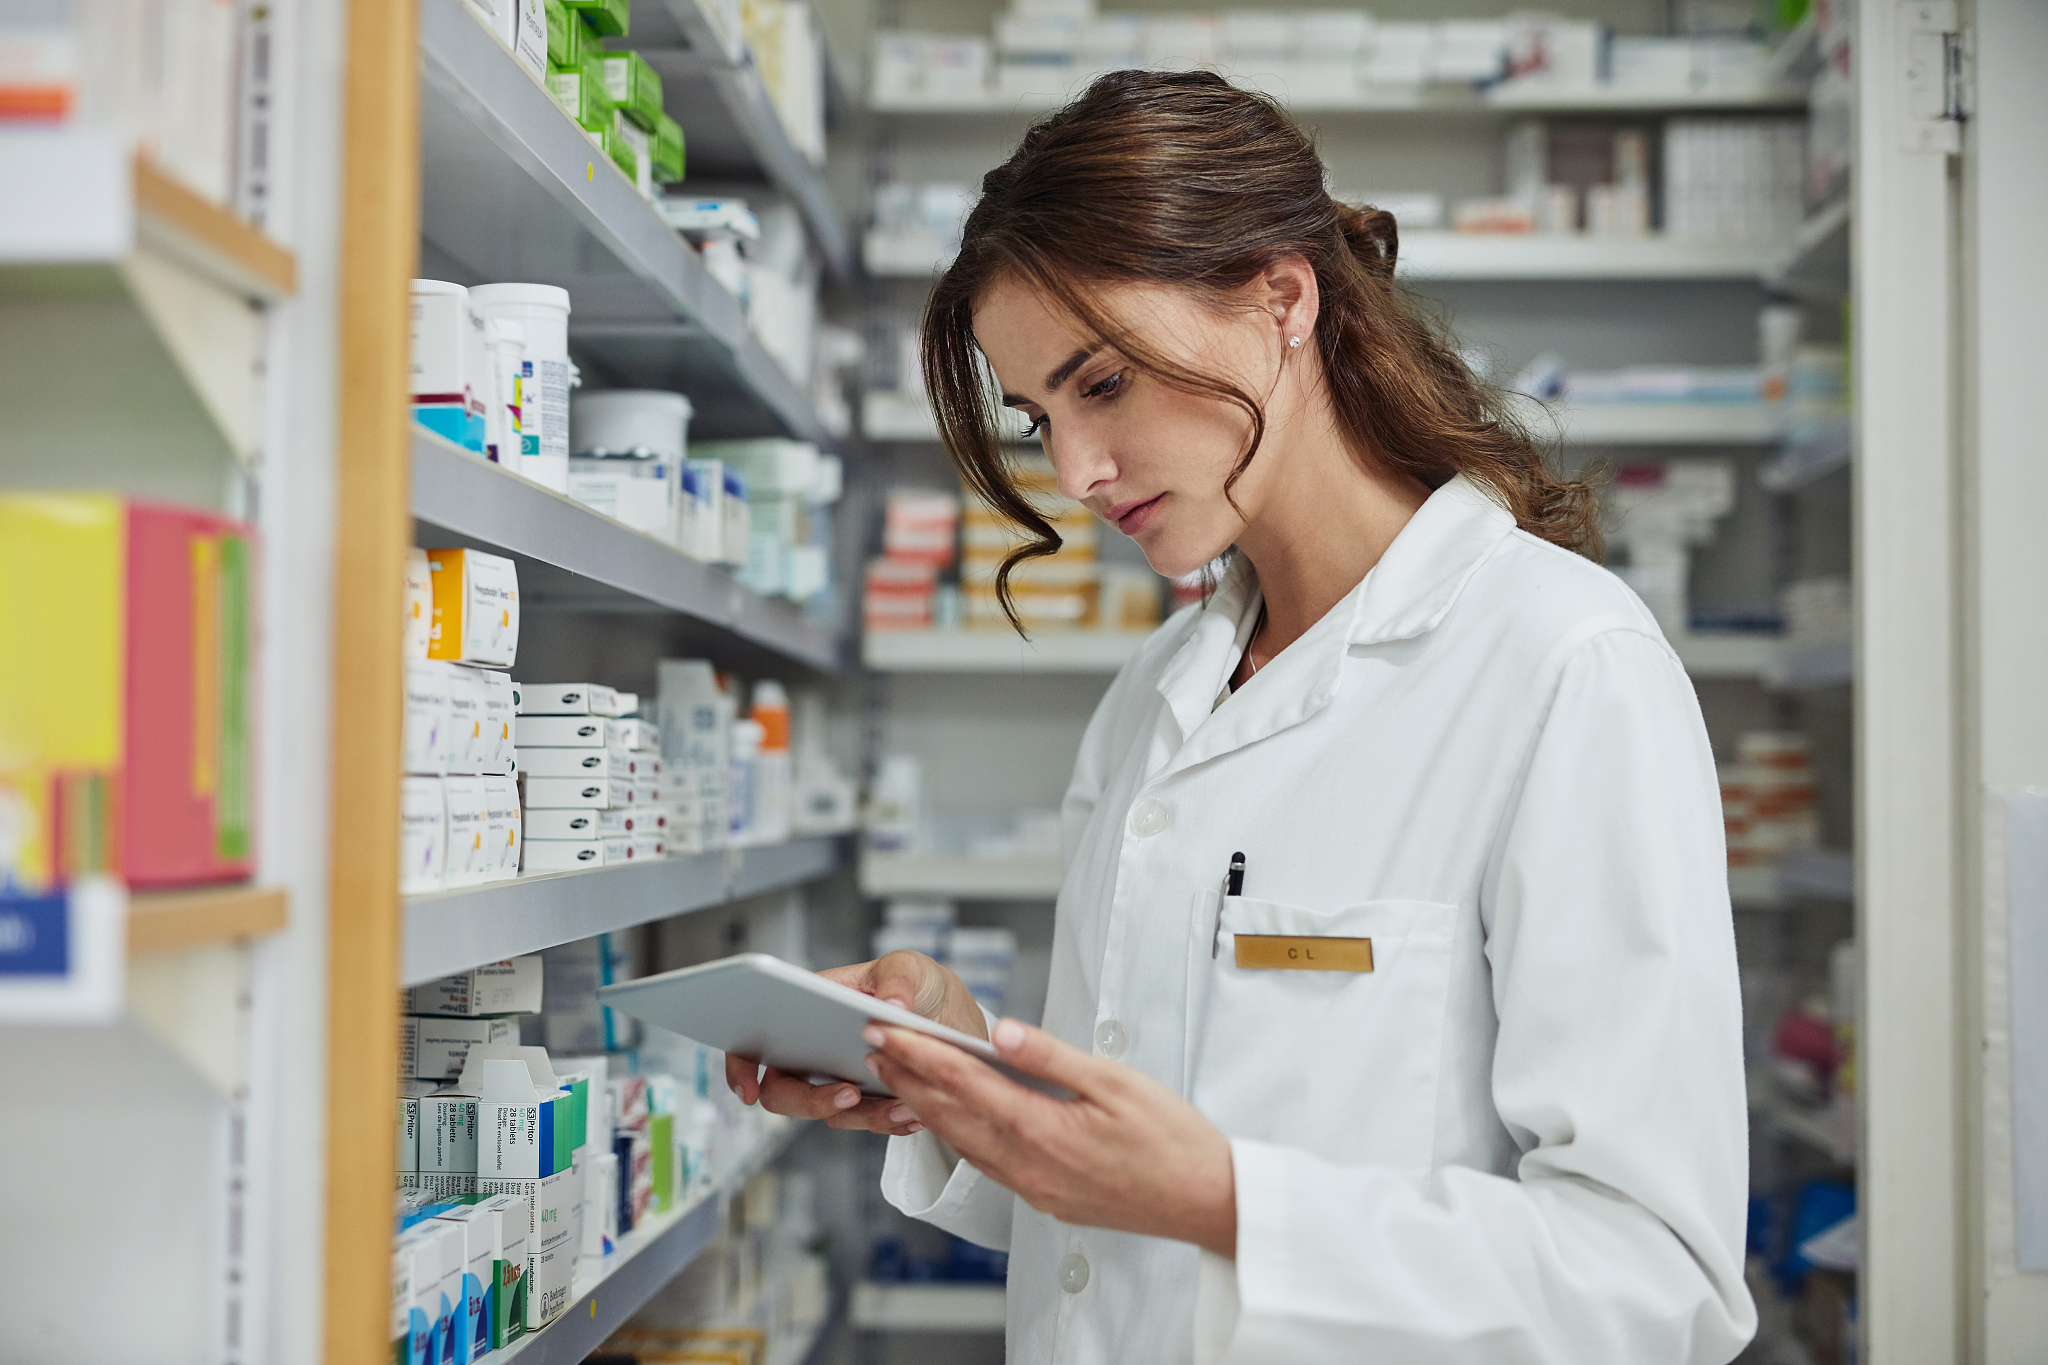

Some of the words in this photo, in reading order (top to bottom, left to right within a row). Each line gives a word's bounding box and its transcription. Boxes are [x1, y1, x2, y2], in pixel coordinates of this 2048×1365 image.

[450, 1103, 456, 1112] 28
[459, 1103, 465, 1112] 40
[510, 1108, 516, 1117] 28
[519, 1108, 525, 1117] 40
[457, 1115, 464, 1126] mg
[517, 1120, 524, 1131] mg
